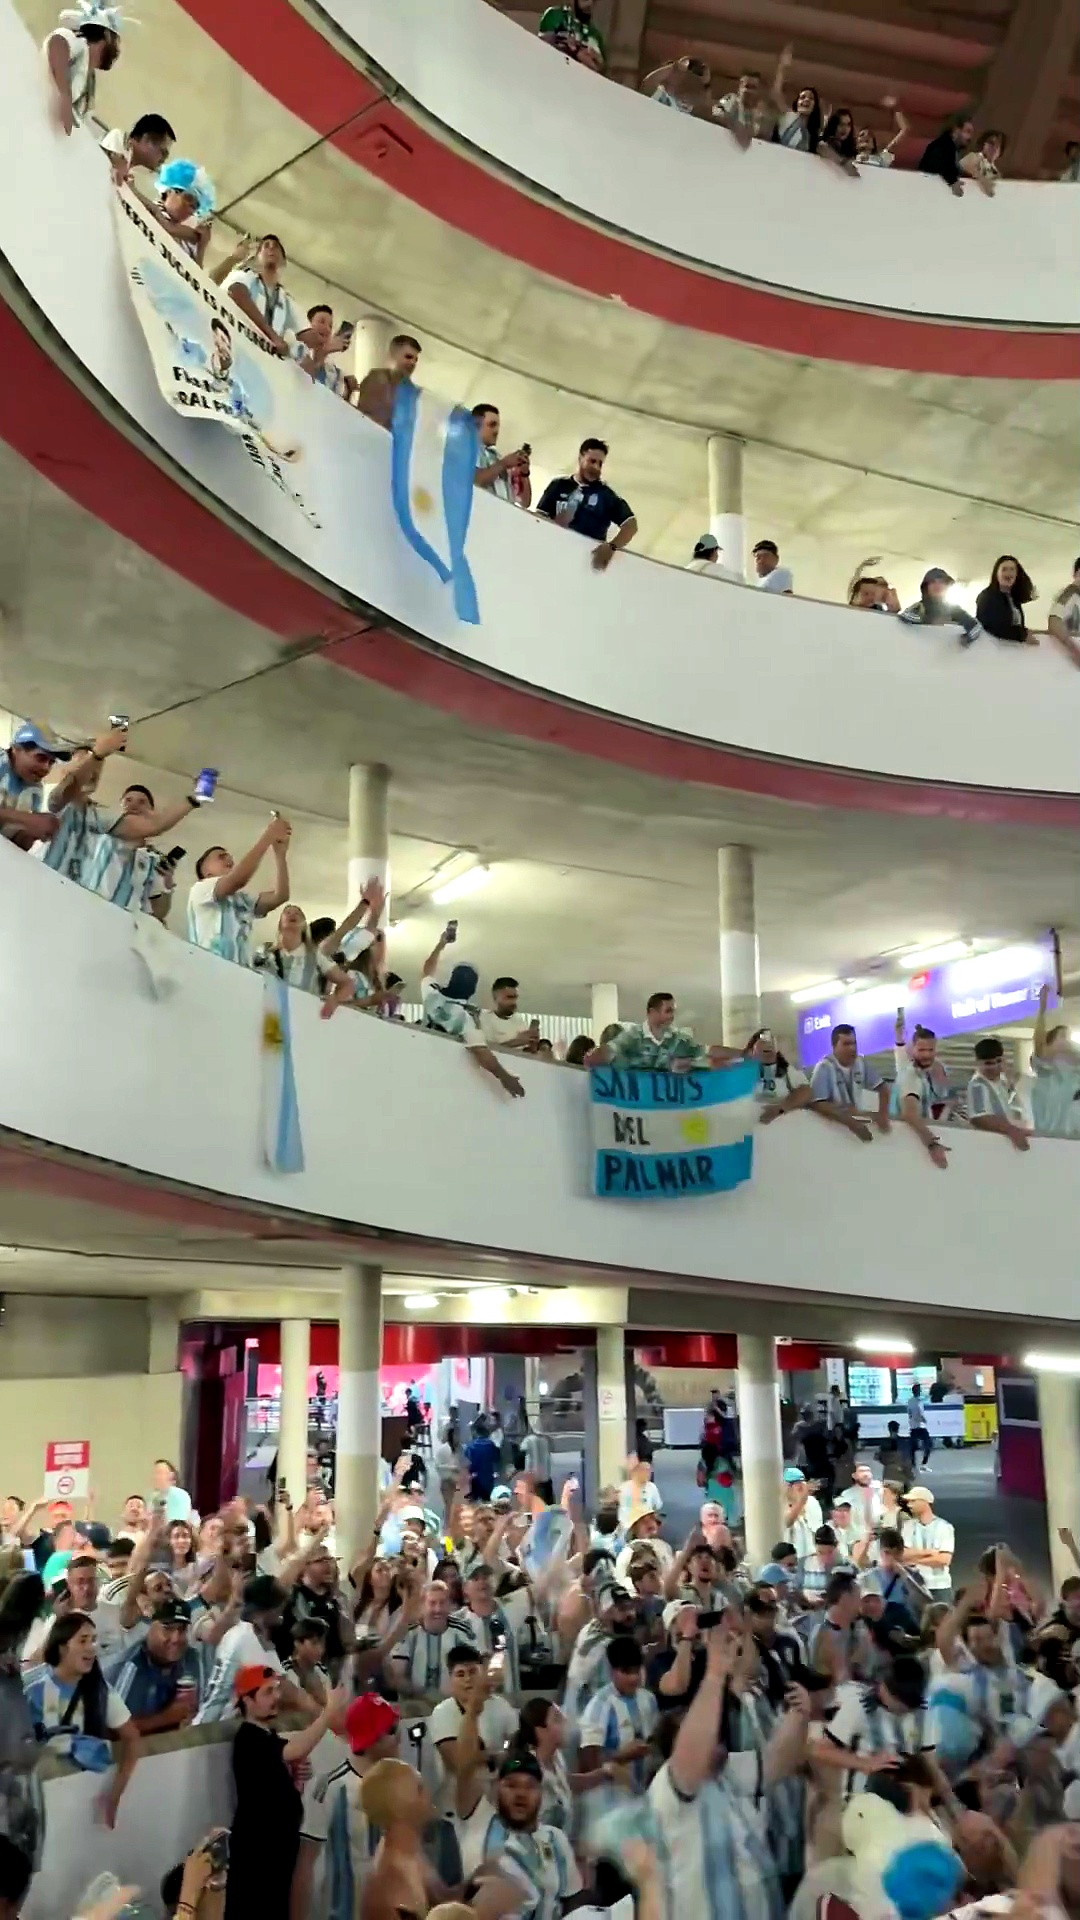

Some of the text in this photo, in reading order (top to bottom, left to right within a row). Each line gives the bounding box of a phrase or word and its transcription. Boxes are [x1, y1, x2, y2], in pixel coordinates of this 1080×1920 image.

[592, 1067, 704, 1105] SAN LUIS
[604, 1155, 715, 1192] PALMAR
